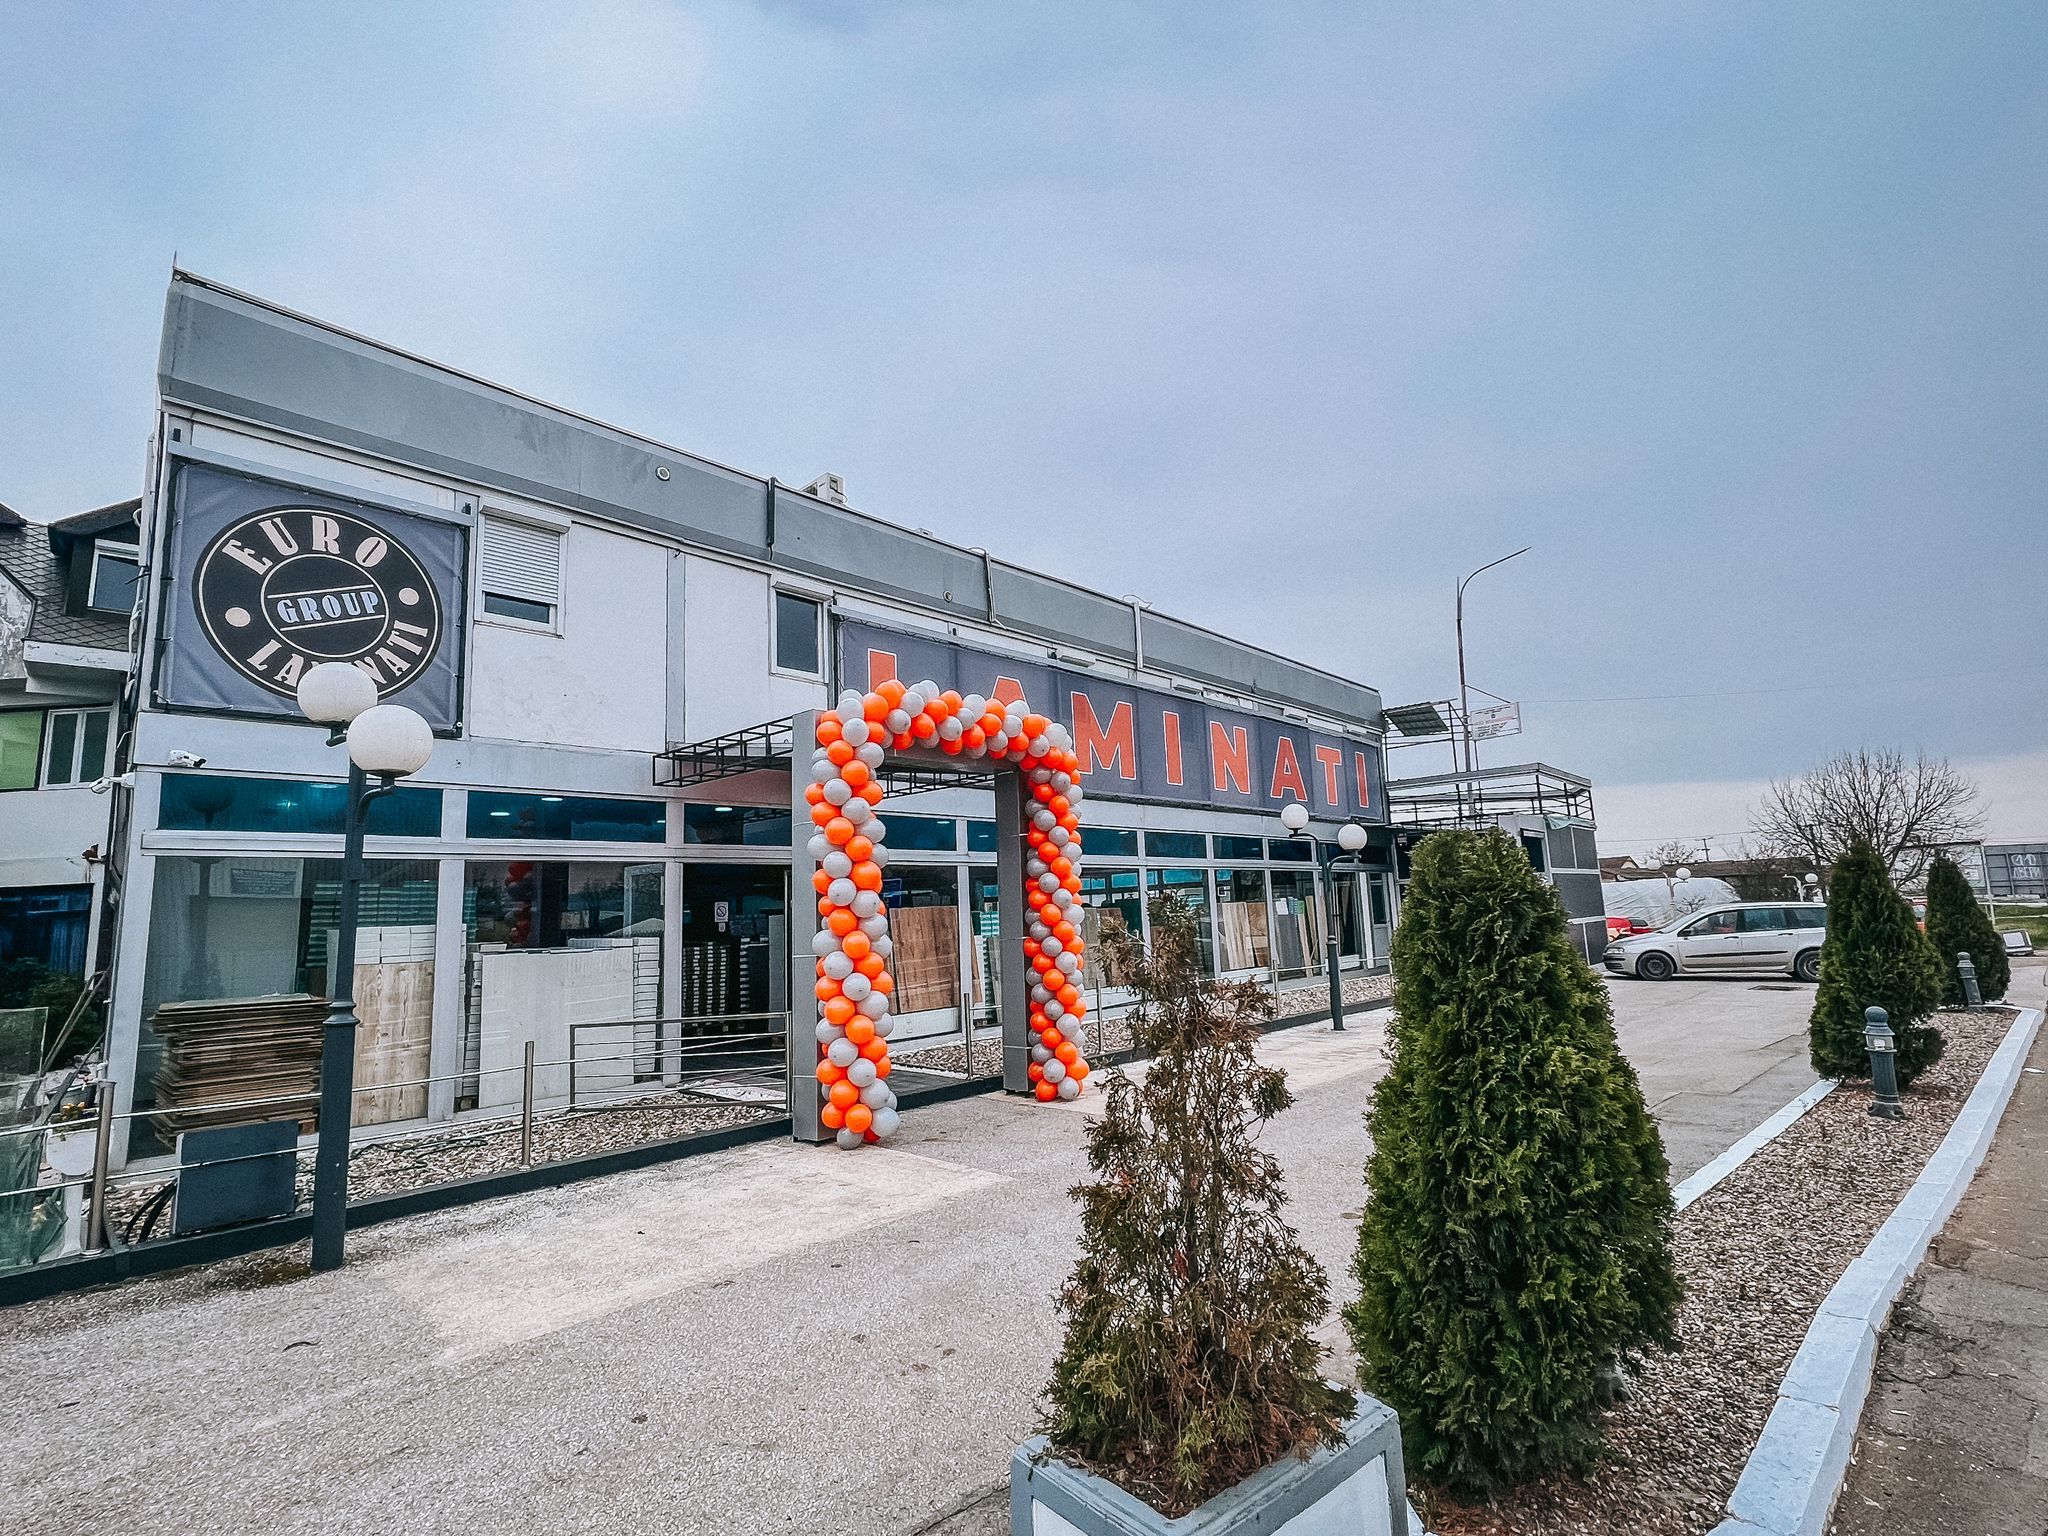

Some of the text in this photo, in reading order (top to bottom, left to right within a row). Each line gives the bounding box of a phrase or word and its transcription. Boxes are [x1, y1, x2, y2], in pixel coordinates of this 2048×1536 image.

[222, 515, 388, 576] EURO
[276, 591, 379, 624] GROUP
[247, 620, 429, 687] LANATI
[867, 647, 1369, 809] MINATI
